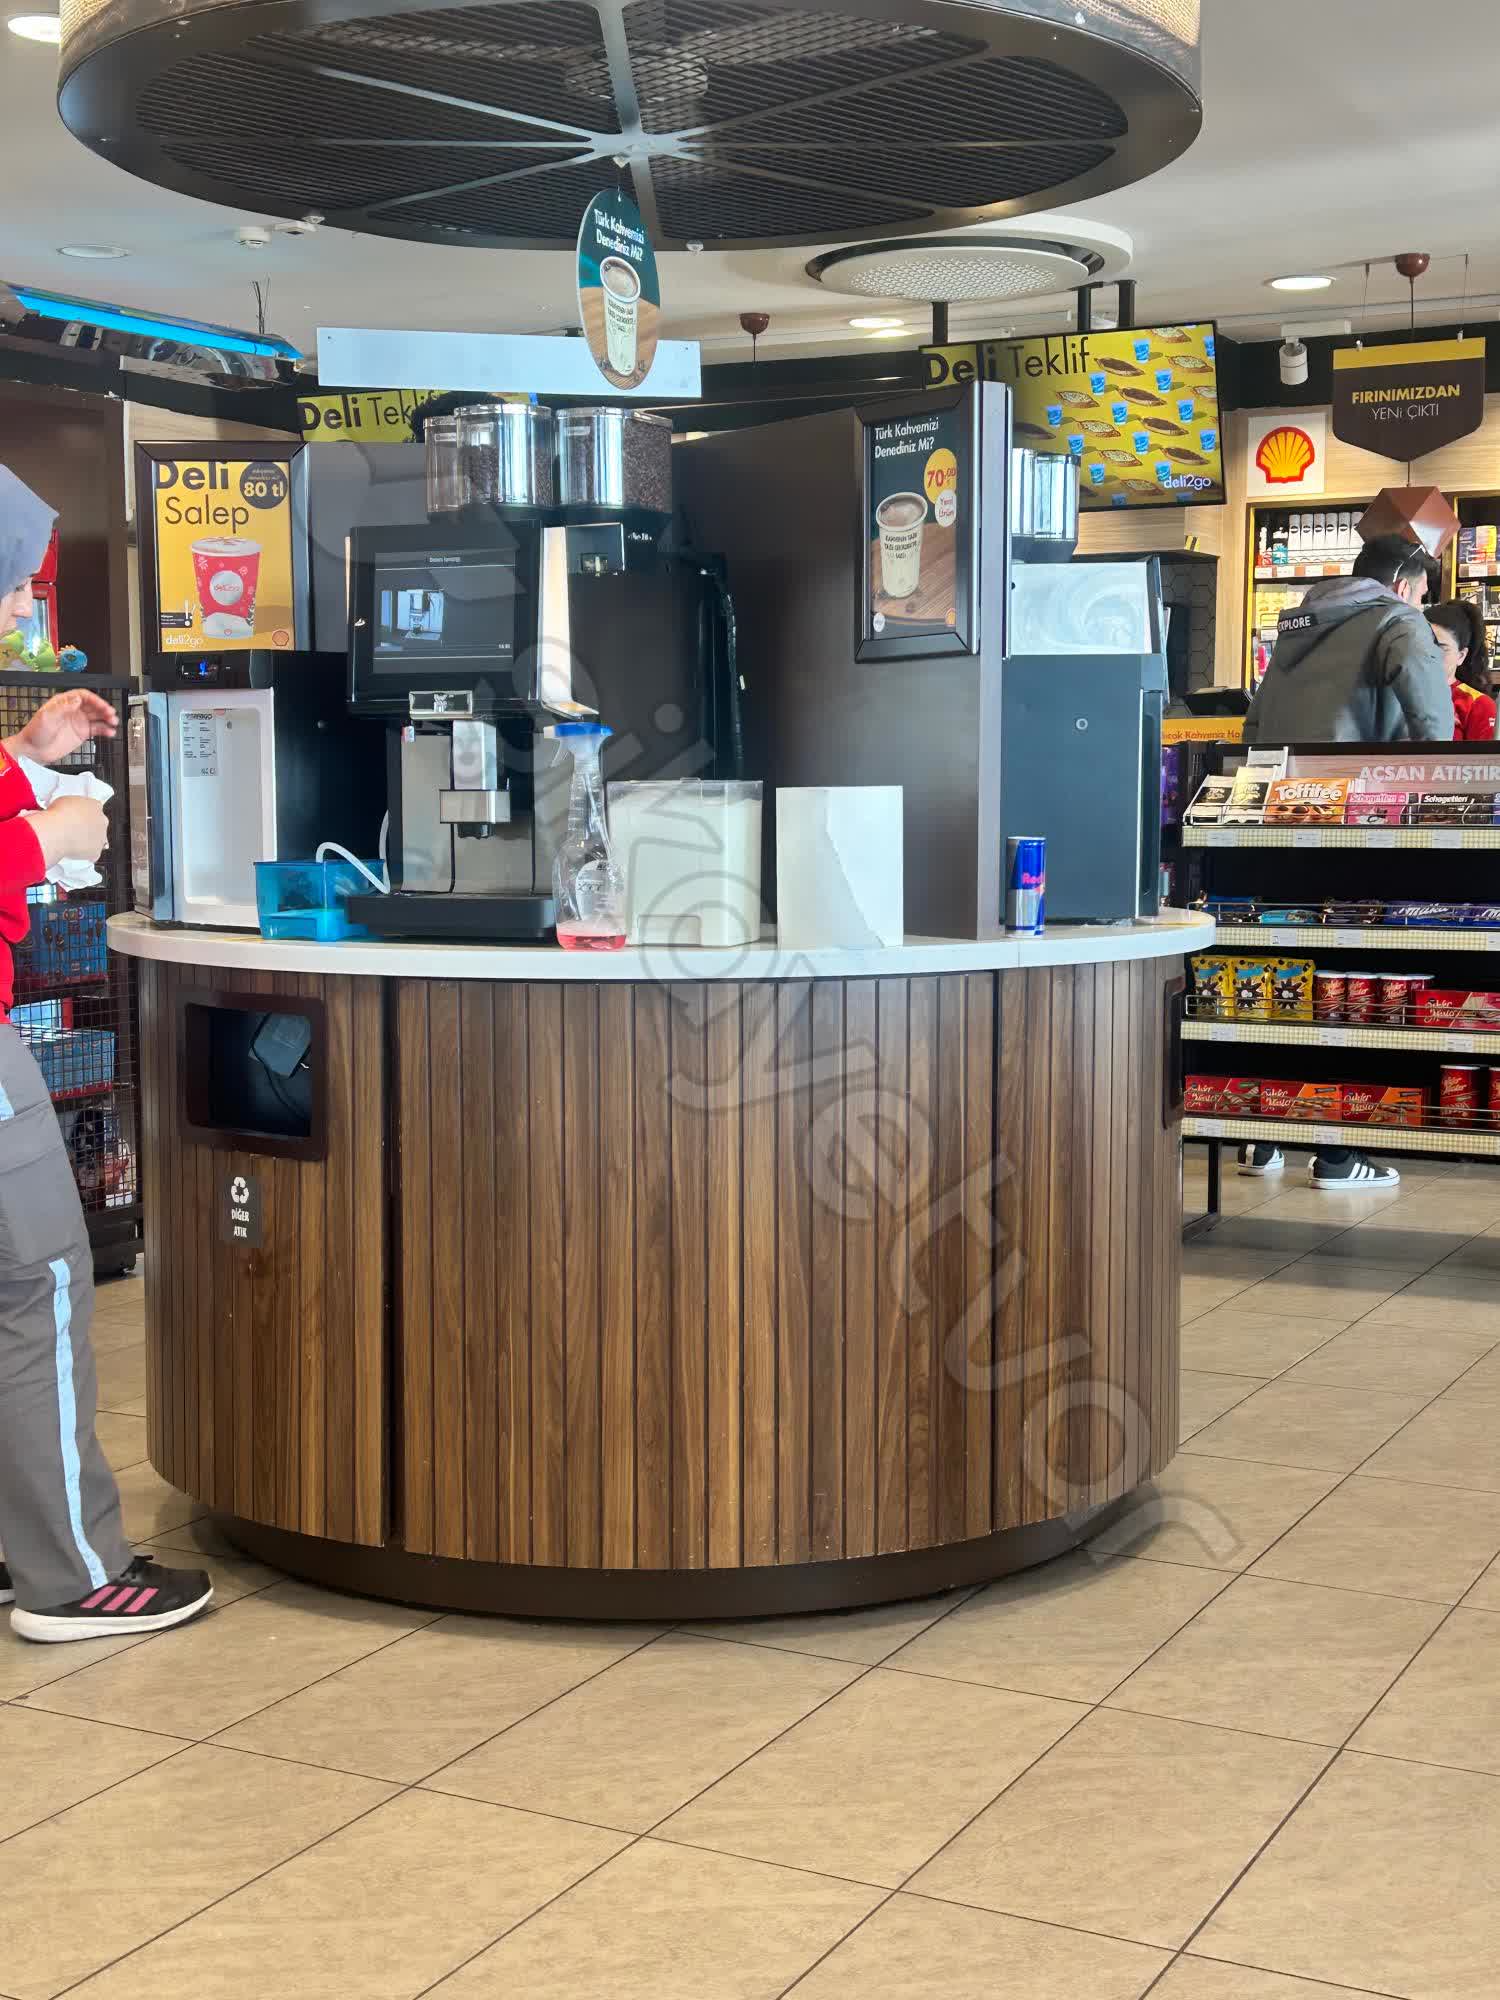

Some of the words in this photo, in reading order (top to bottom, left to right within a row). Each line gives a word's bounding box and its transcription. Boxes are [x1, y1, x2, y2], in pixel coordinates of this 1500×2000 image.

[594, 208, 610, 230] Türk
[926, 345, 997, 386] Deli
[1007, 336, 1090, 378] Teklif
[1351, 384, 1460, 404] FIRINIMIZDAN
[299, 394, 362, 431] Deli
[1406, 403, 1440, 420] ÇIKTI
[874, 424, 893, 440] Türk
[895, 417, 939, 437] Kahvemizi
[874, 440, 917, 459] Denediniz
[917, 436, 935, 452] Mi?
[155, 461, 229, 490] Deli
[1163, 475, 1212, 491] deli2go
[243, 482, 266, 497] 80
[164, 494, 250, 534] Salep
[1275, 782, 1343, 802] Toffifee
